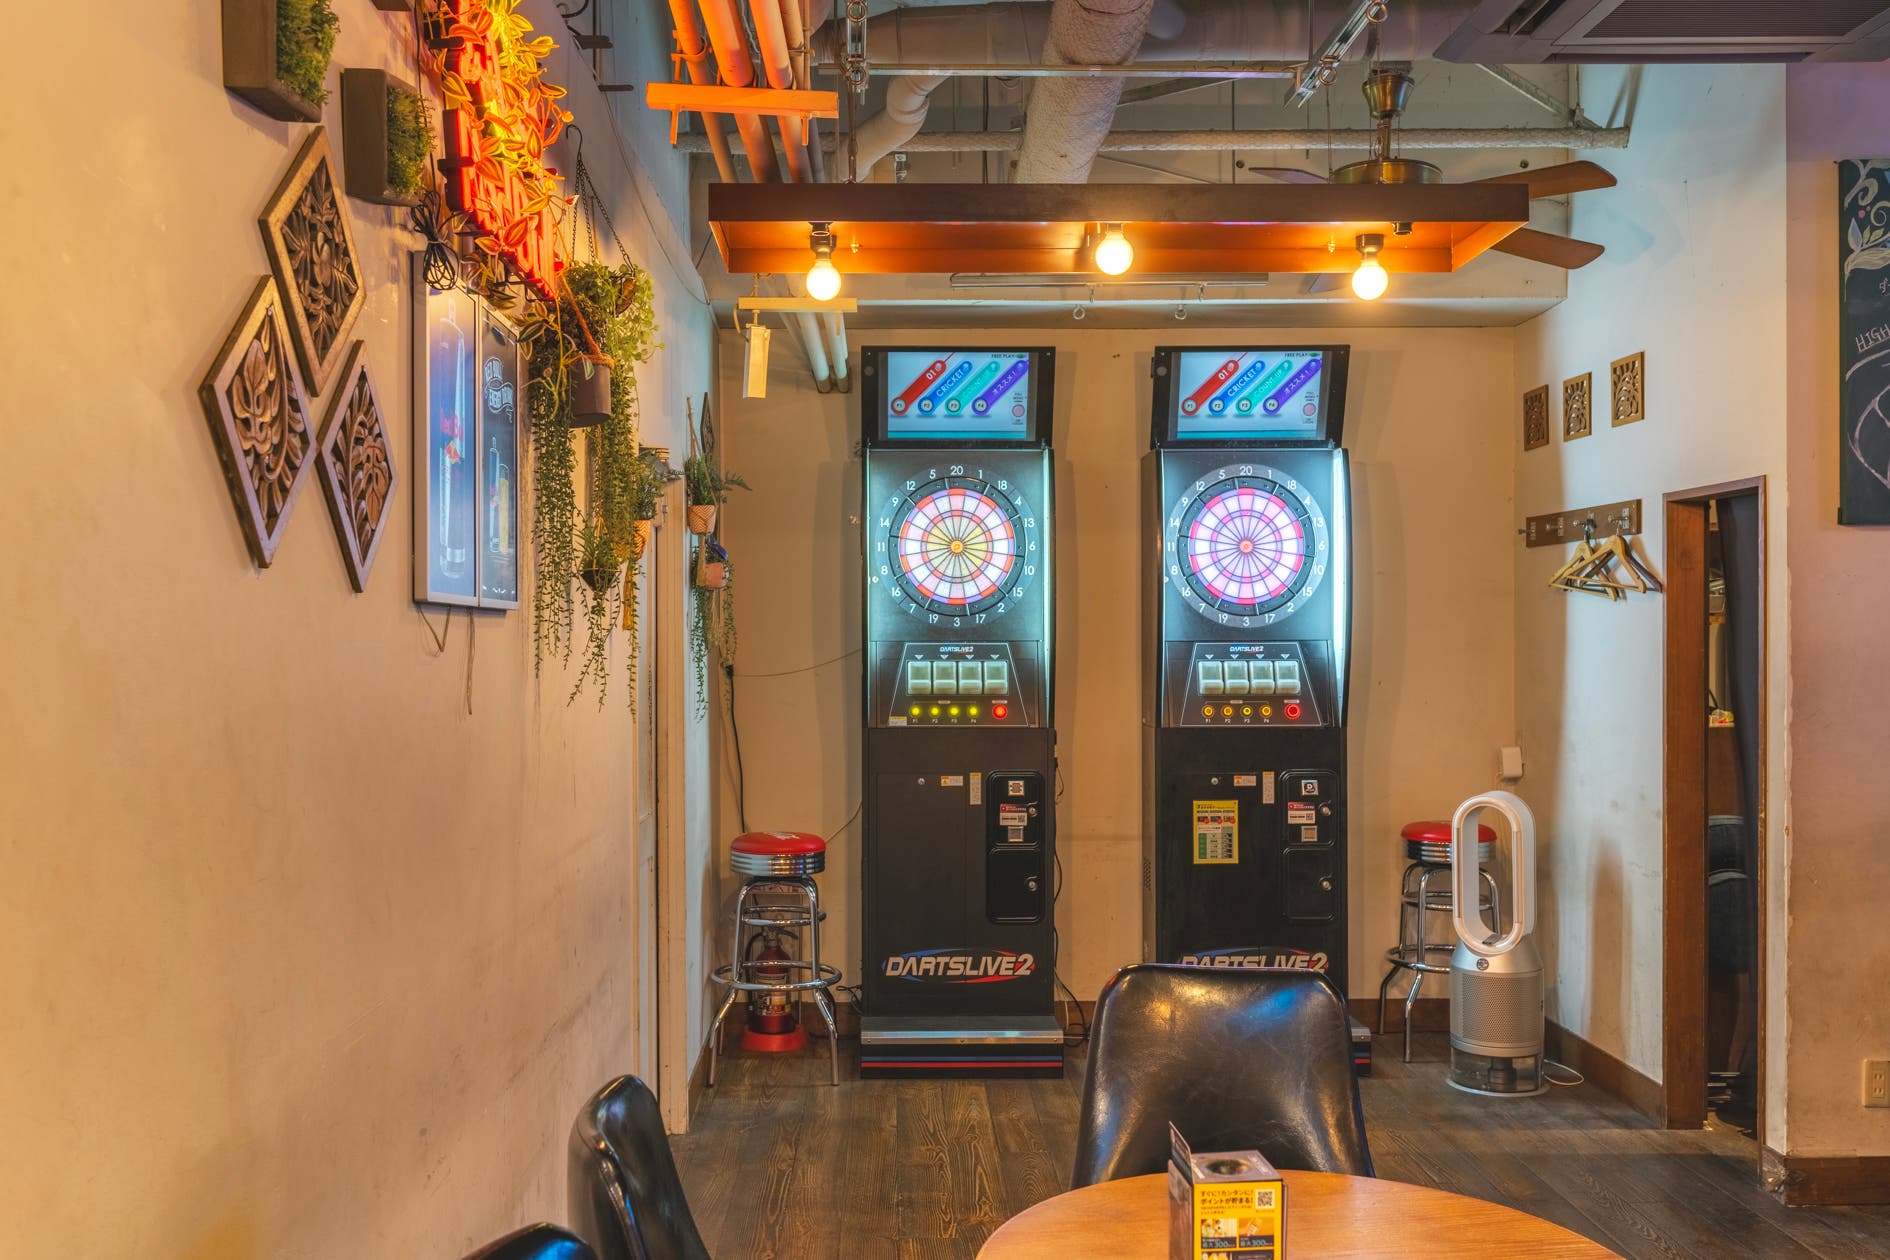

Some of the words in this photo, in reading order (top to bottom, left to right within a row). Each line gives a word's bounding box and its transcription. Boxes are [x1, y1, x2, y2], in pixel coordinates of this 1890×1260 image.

[926, 370, 936, 380] 01
[1218, 370, 1228, 380] 01
[936, 369, 964, 397] CRICKET
[1228, 368, 1256, 397] CRICKET
[930, 470, 935, 478] 5
[951, 466, 963, 475] 20
[979, 470, 982, 478] 1
[1219, 470, 1225, 478] 5
[1240, 466, 1252, 475] 20
[1268, 470, 1272, 478] 1
[907, 481, 915, 490] 12
[998, 481, 1007, 489] 18
[1197, 481, 1205, 489] 12
[1288, 480, 1296, 489] 18
[892, 497, 898, 505] 9
[1015, 497, 1021, 505] 4
[1182, 497, 1188, 505] 9
[1304, 497, 1311, 505] 4
[881, 518, 889, 527] 14
[1025, 518, 1034, 527] 13
[1171, 518, 1179, 527] 14
[1314, 518, 1323, 527] 13
[878, 542, 885, 551] 11
[1029, 542, 1035, 551] 6
[1168, 542, 1175, 551] 11
[1319, 542, 1325, 550] 6
[881, 566, 888, 575] 8
[1025, 566, 1034, 575] 10
[1171, 566, 1178, 575] 8
[1314, 566, 1323, 574] 10
[892, 588, 900, 596] 16
[1013, 588, 1022, 596] 15
[1182, 588, 1190, 596] 16
[1303, 588, 1312, 596] 15
[910, 604, 916, 613] 7
[998, 604, 1004, 612] 2
[1200, 604, 1206, 613] 7
[1288, 603, 1293, 612] 2
[929, 614, 938, 623] 19
[954, 618, 960, 627] 3
[976, 615, 985, 623] 17
[1219, 614, 1228, 623] 19
[1243, 617, 1249, 626] 3
[1265, 614, 1275, 623] 17
[886, 953, 1034, 976] DARTSLIVE2
